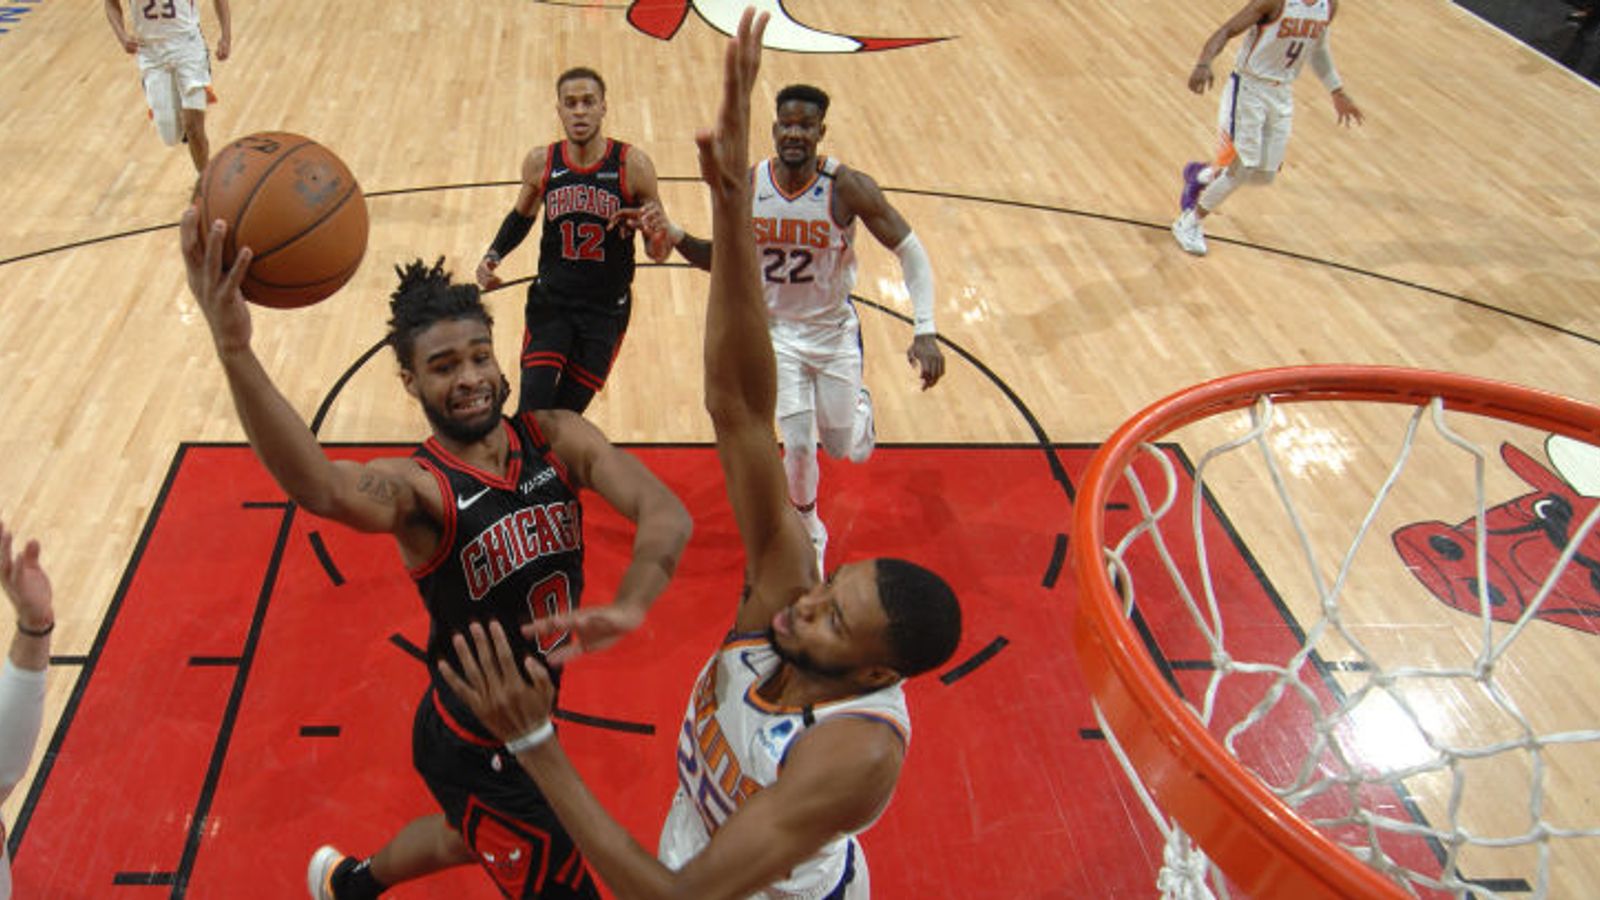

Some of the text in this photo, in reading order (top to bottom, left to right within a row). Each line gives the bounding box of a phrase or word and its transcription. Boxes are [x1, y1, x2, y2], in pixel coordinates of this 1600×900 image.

[143, 0, 176, 19] 23
[1285, 40, 1304, 69] 4
[560, 220, 605, 262] 12
[752, 216, 830, 249] SUNS
[763, 247, 815, 284] 22
[460, 501, 582, 600] CHICAG
